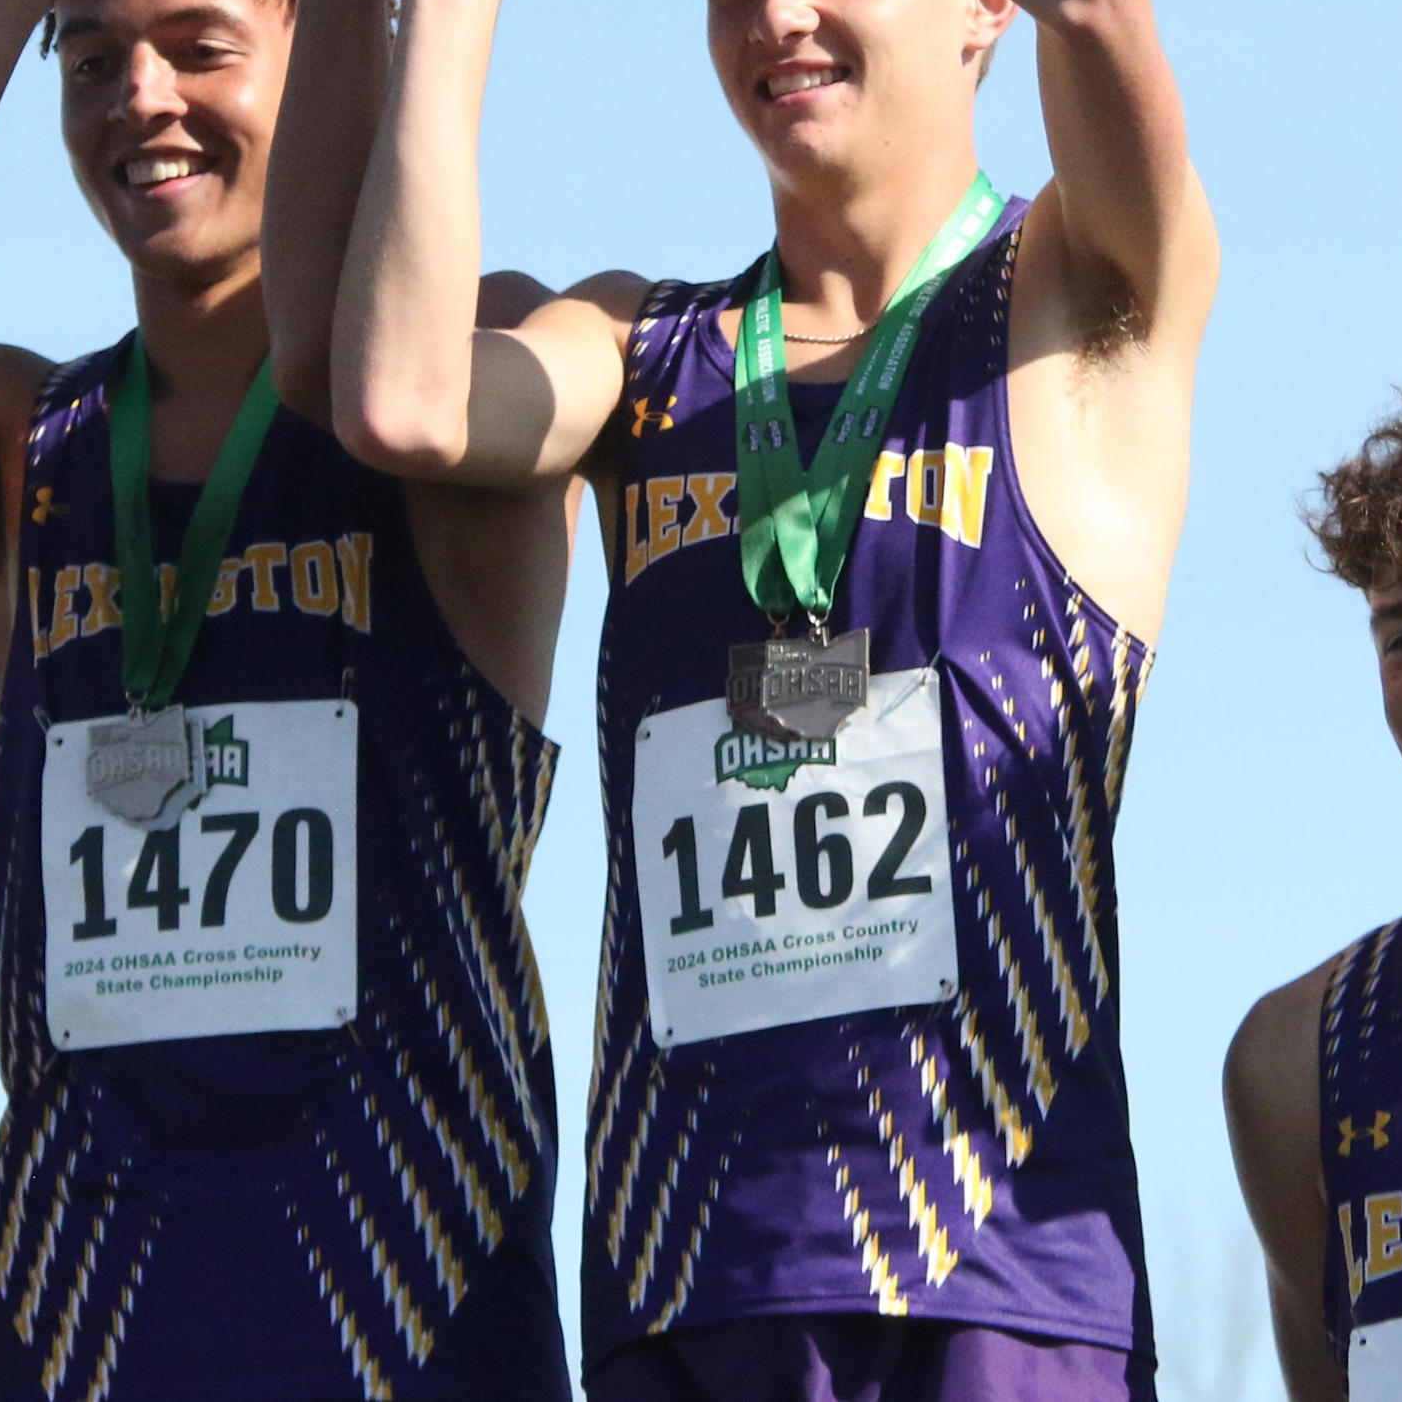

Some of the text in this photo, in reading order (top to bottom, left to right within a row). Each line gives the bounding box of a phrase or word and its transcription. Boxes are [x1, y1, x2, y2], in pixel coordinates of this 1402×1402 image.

[625, 442, 995, 588] LEXTON
[69, 807, 334, 942] 1470
[661, 779, 932, 936] 1462
[64, 944, 321, 978] 2024 OHSAA Cross Country
[667, 919, 919, 973] 2024 OHSAA Cross Country
[698, 945, 883, 988] State Championship
[96, 967, 283, 995] State Championship
